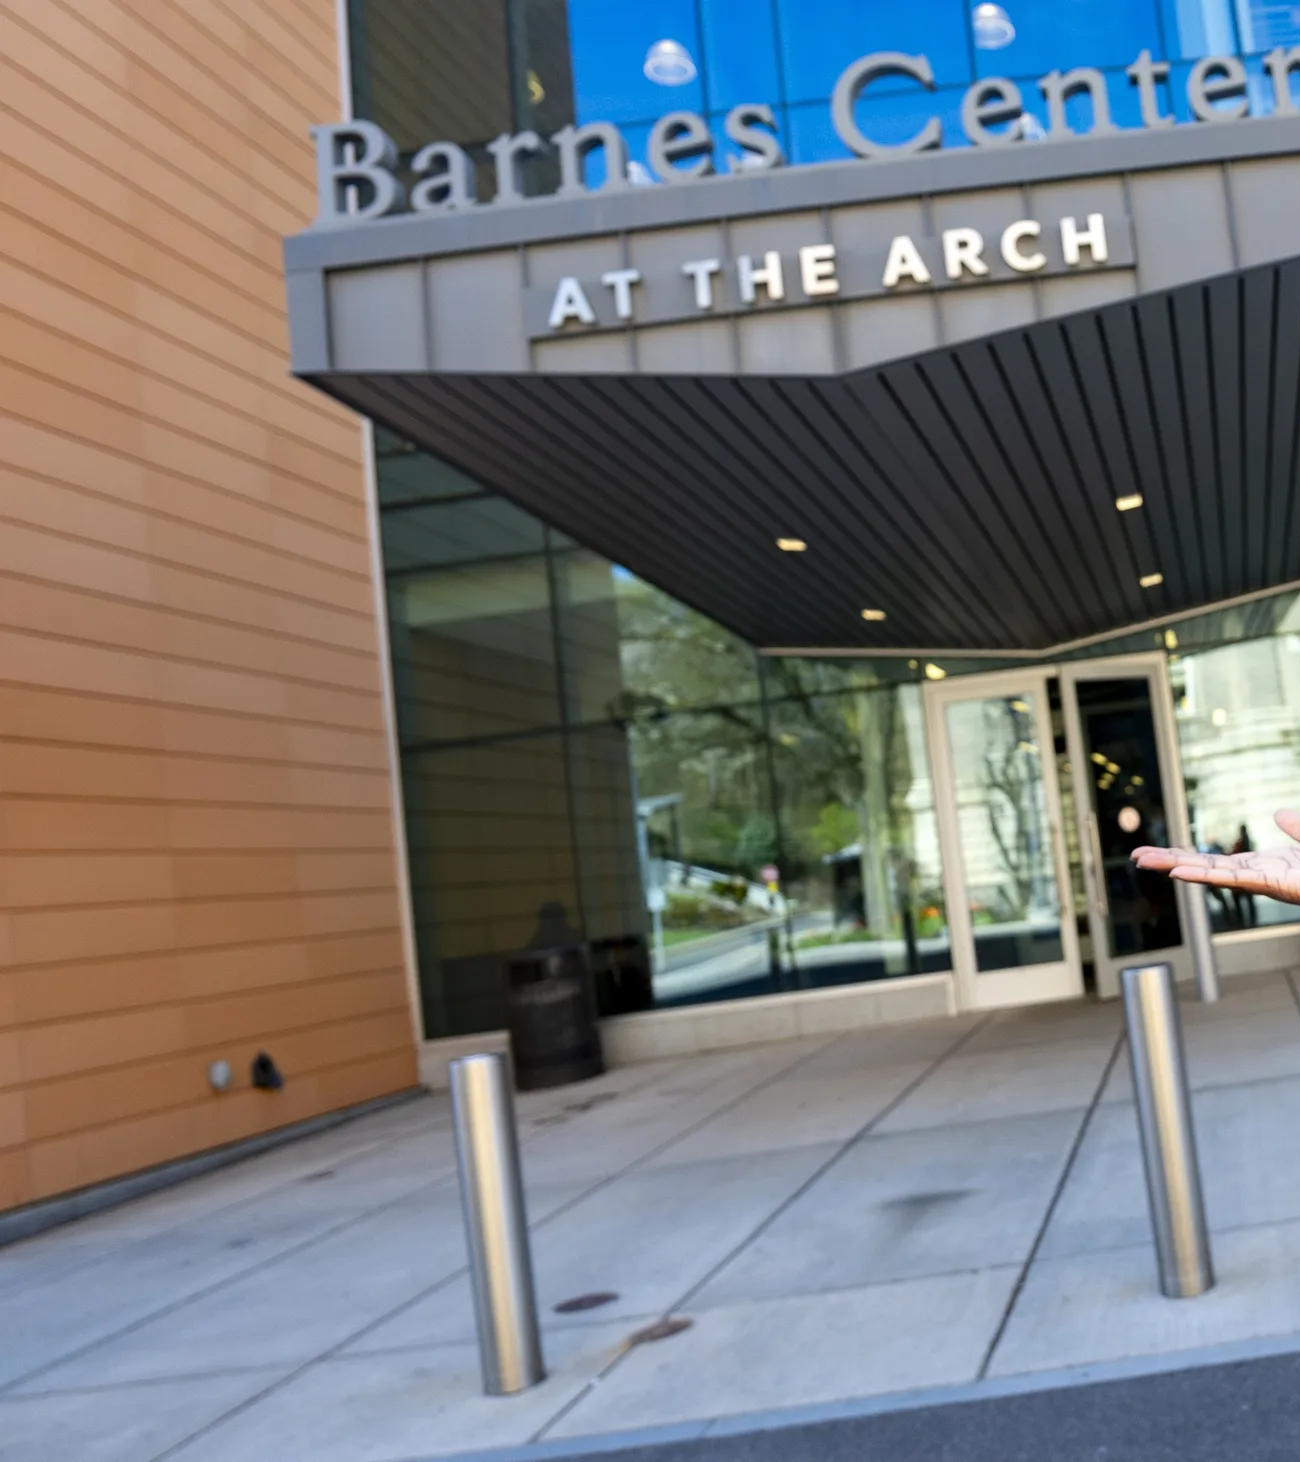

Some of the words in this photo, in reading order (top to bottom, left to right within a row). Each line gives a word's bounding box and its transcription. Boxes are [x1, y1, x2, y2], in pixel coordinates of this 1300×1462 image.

[312, 103, 785, 220] Barnes
[549, 269, 642, 328] AT
[682, 244, 840, 309] THE
[883, 213, 1109, 288] ARCH
